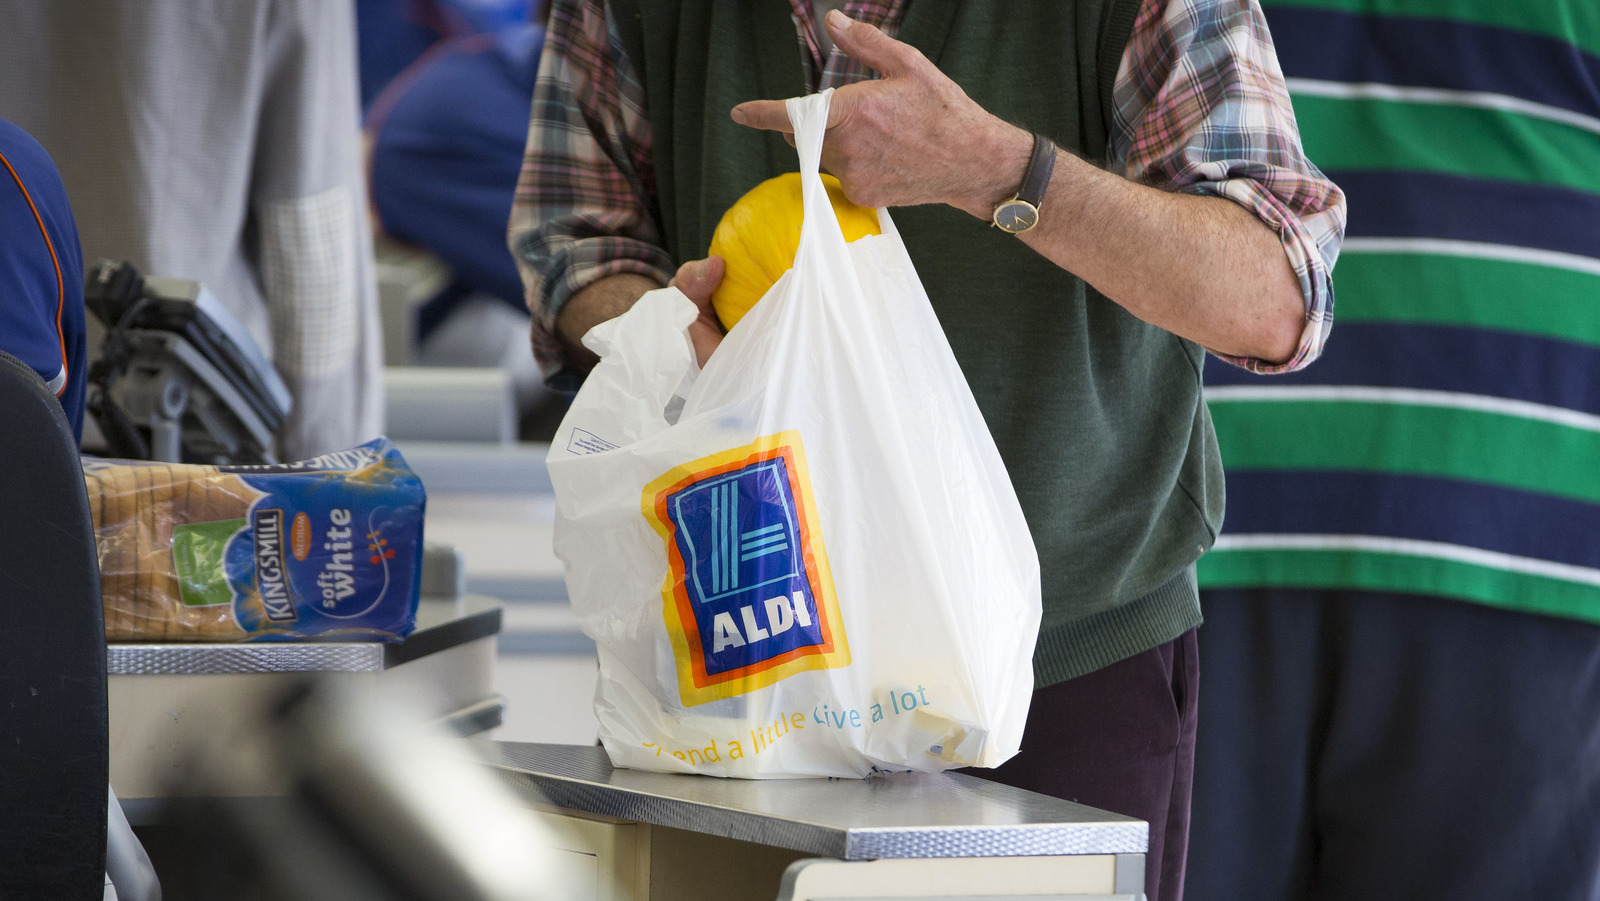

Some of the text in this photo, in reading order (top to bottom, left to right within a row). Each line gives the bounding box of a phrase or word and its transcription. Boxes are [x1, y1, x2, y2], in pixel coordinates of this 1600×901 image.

[258, 515, 293, 618] KINGSMILL
[296, 515, 306, 558] MEDIUM
[324, 508, 356, 601] white
[317, 571, 336, 608] soft
[713, 590, 812, 653] ALDI
[728, 740, 744, 760] a
[750, 712, 805, 754] little
[870, 703, 884, 723] a
[890, 684, 930, 715] lot
